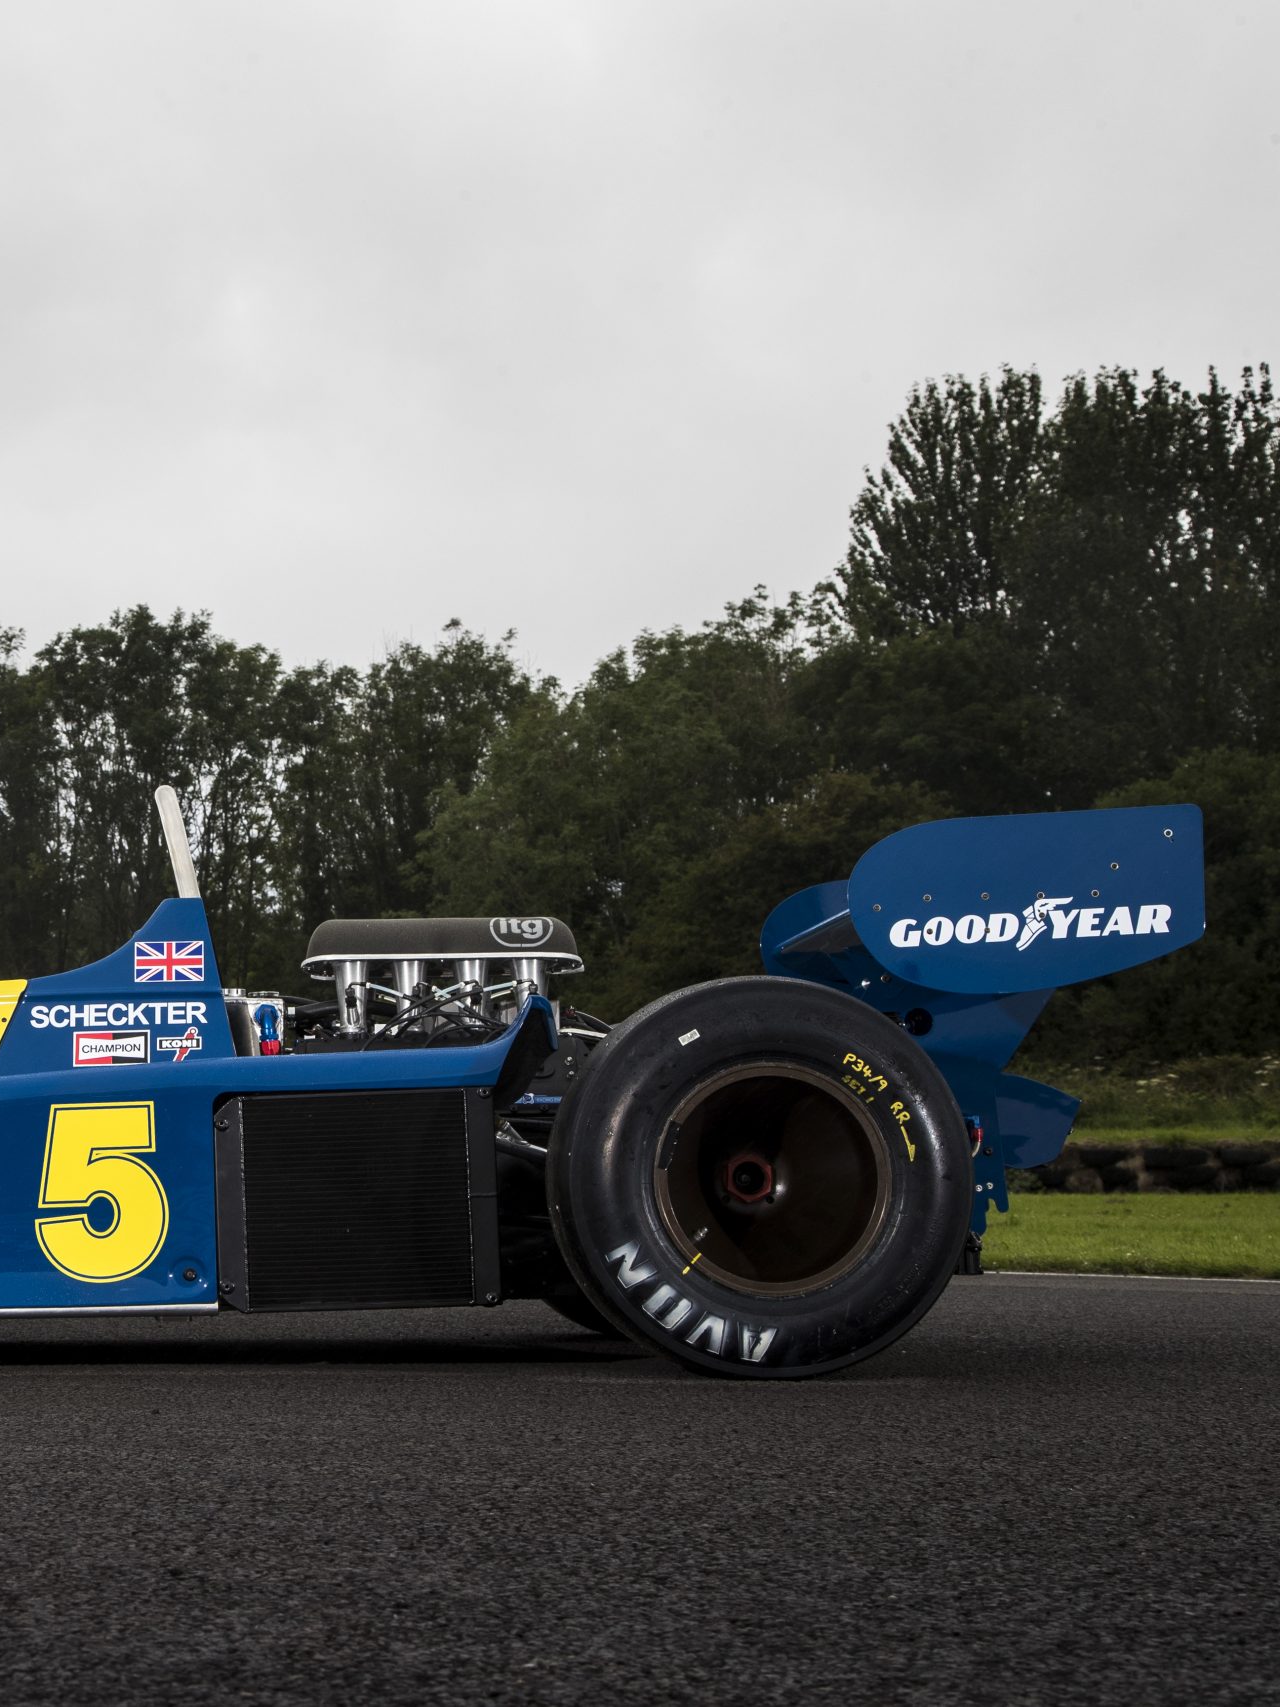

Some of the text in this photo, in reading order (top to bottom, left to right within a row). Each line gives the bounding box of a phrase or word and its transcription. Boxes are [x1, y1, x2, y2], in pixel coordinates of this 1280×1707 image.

[30, 1002, 208, 1029] SCHECKTER
[81, 1043, 141, 1054] CHAMPION
[161, 1039, 198, 1049] KONI
[842, 1053, 888, 1092] P34/9
[35, 1101, 169, 1283] 5
[605, 1239, 777, 1363] AVON
